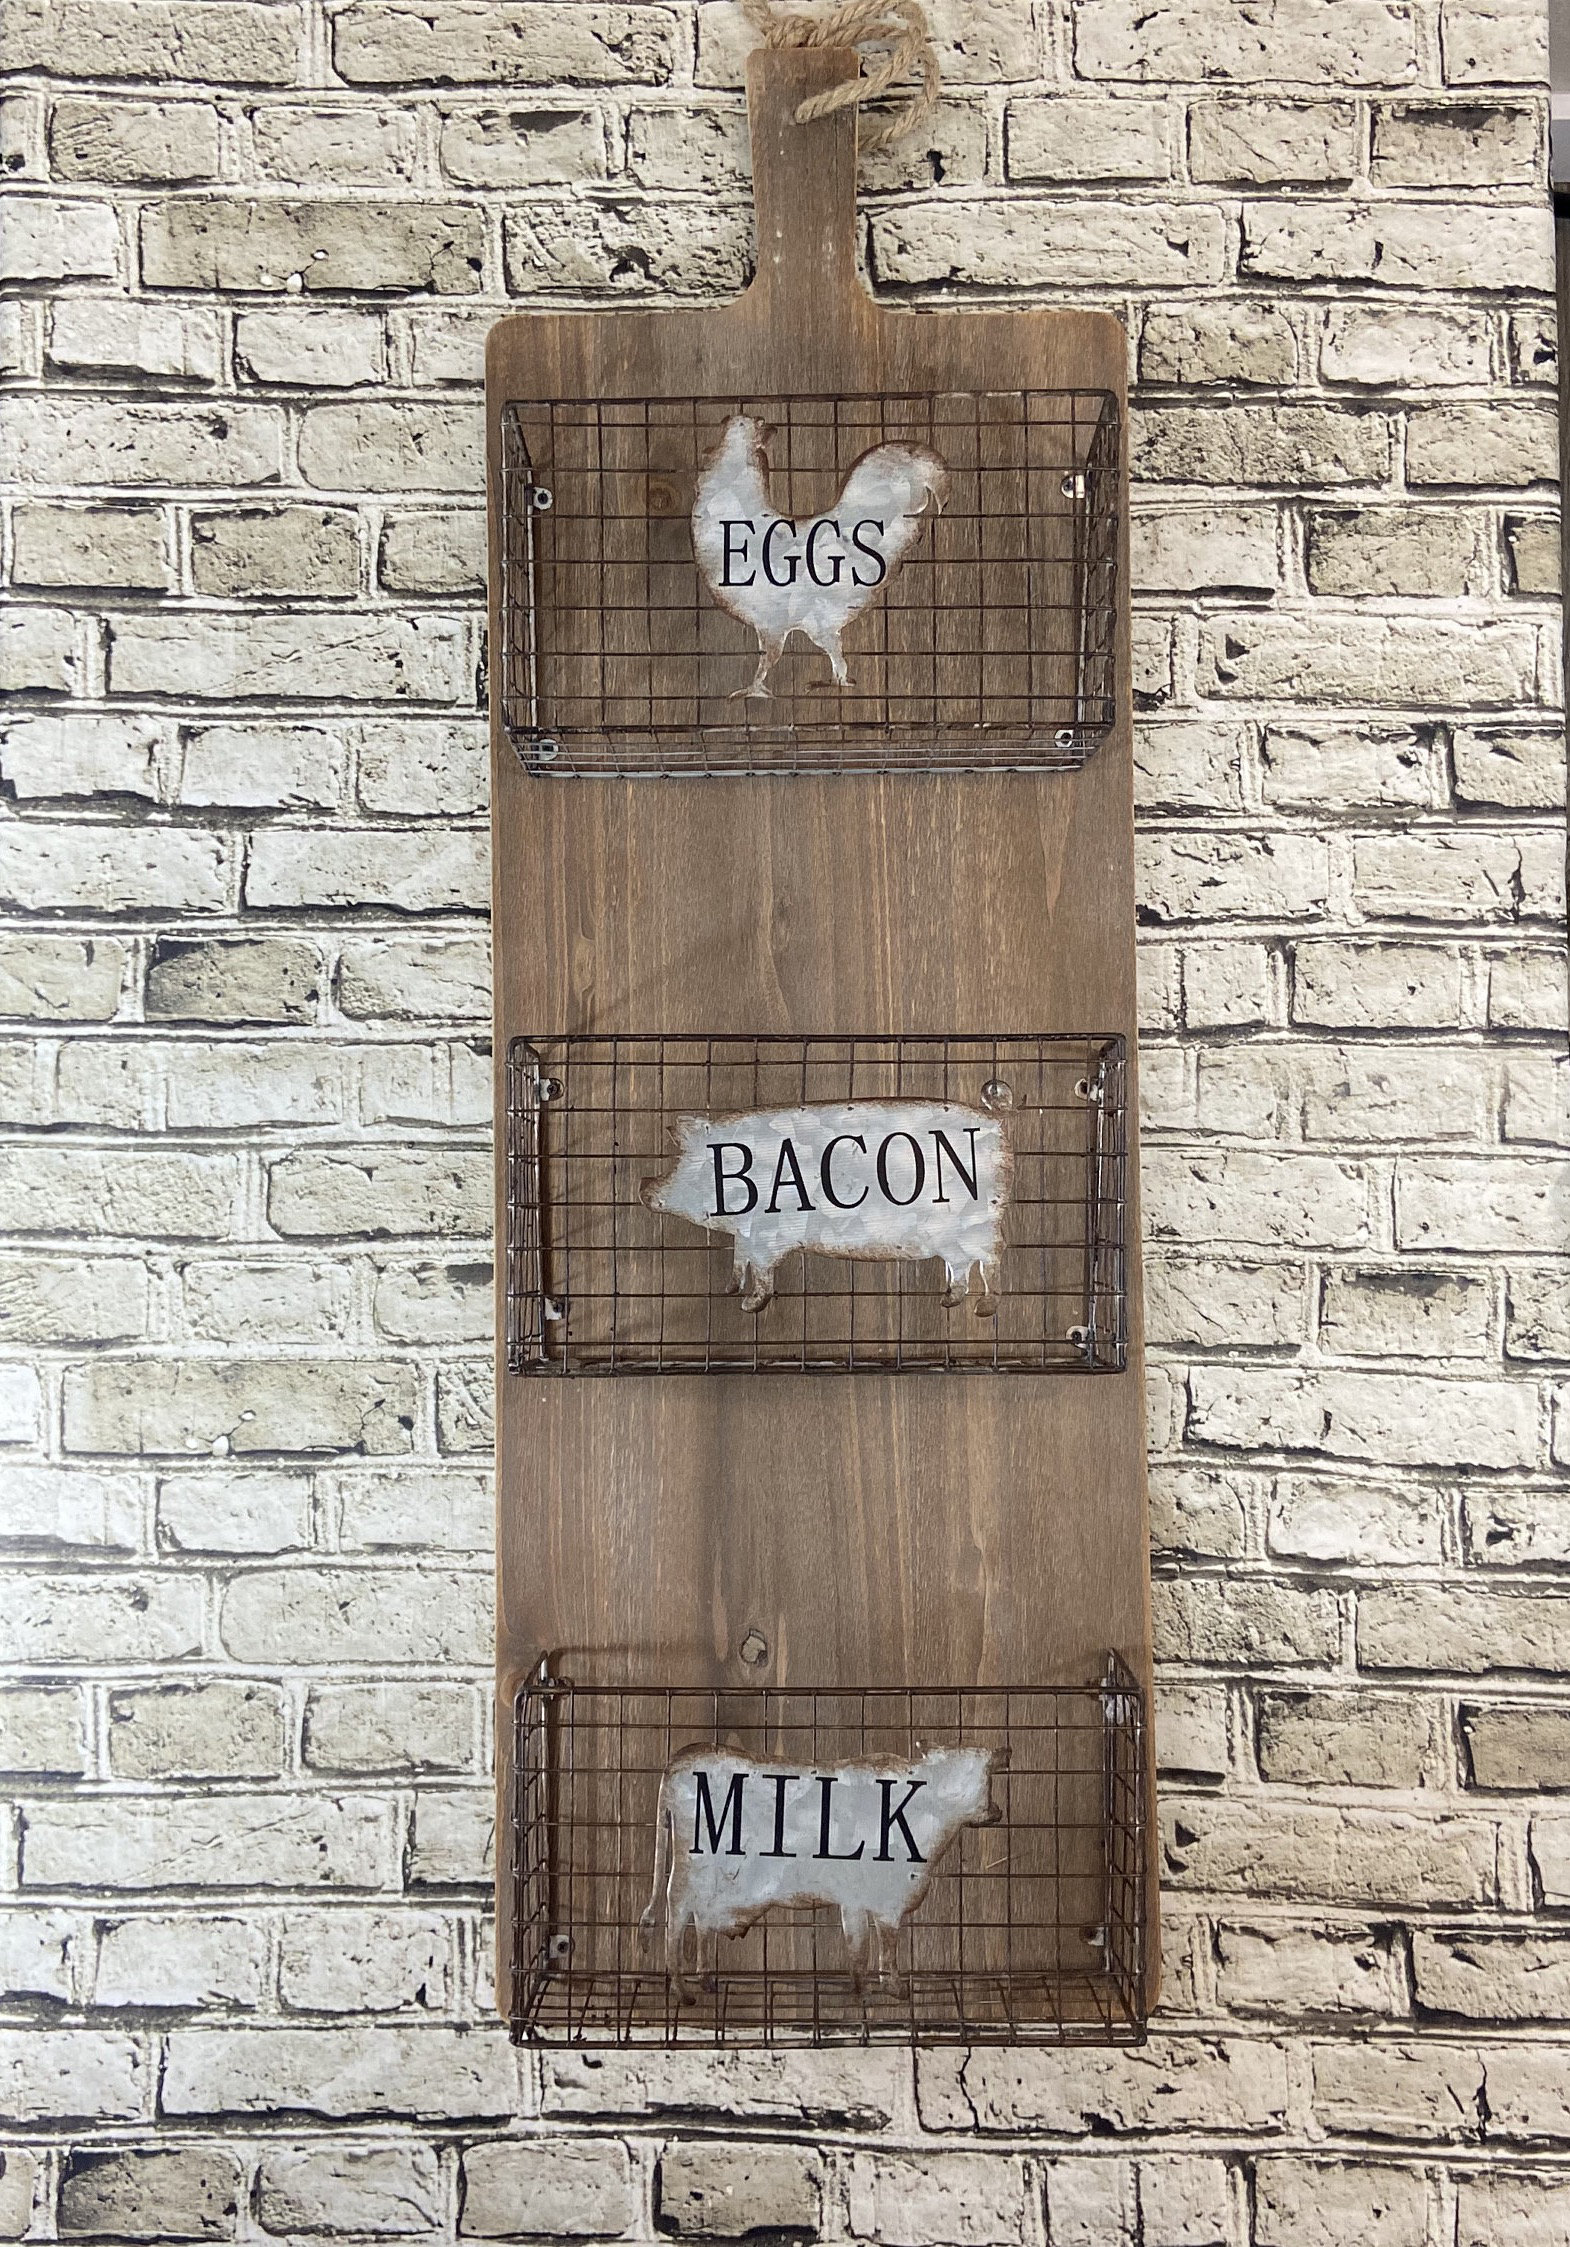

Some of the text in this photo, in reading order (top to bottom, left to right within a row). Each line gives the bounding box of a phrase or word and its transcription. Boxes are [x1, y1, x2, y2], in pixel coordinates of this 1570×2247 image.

[718, 519, 886, 587] EGGS
[706, 1127, 980, 1217] BACON
[688, 1771, 928, 1863] MILK
